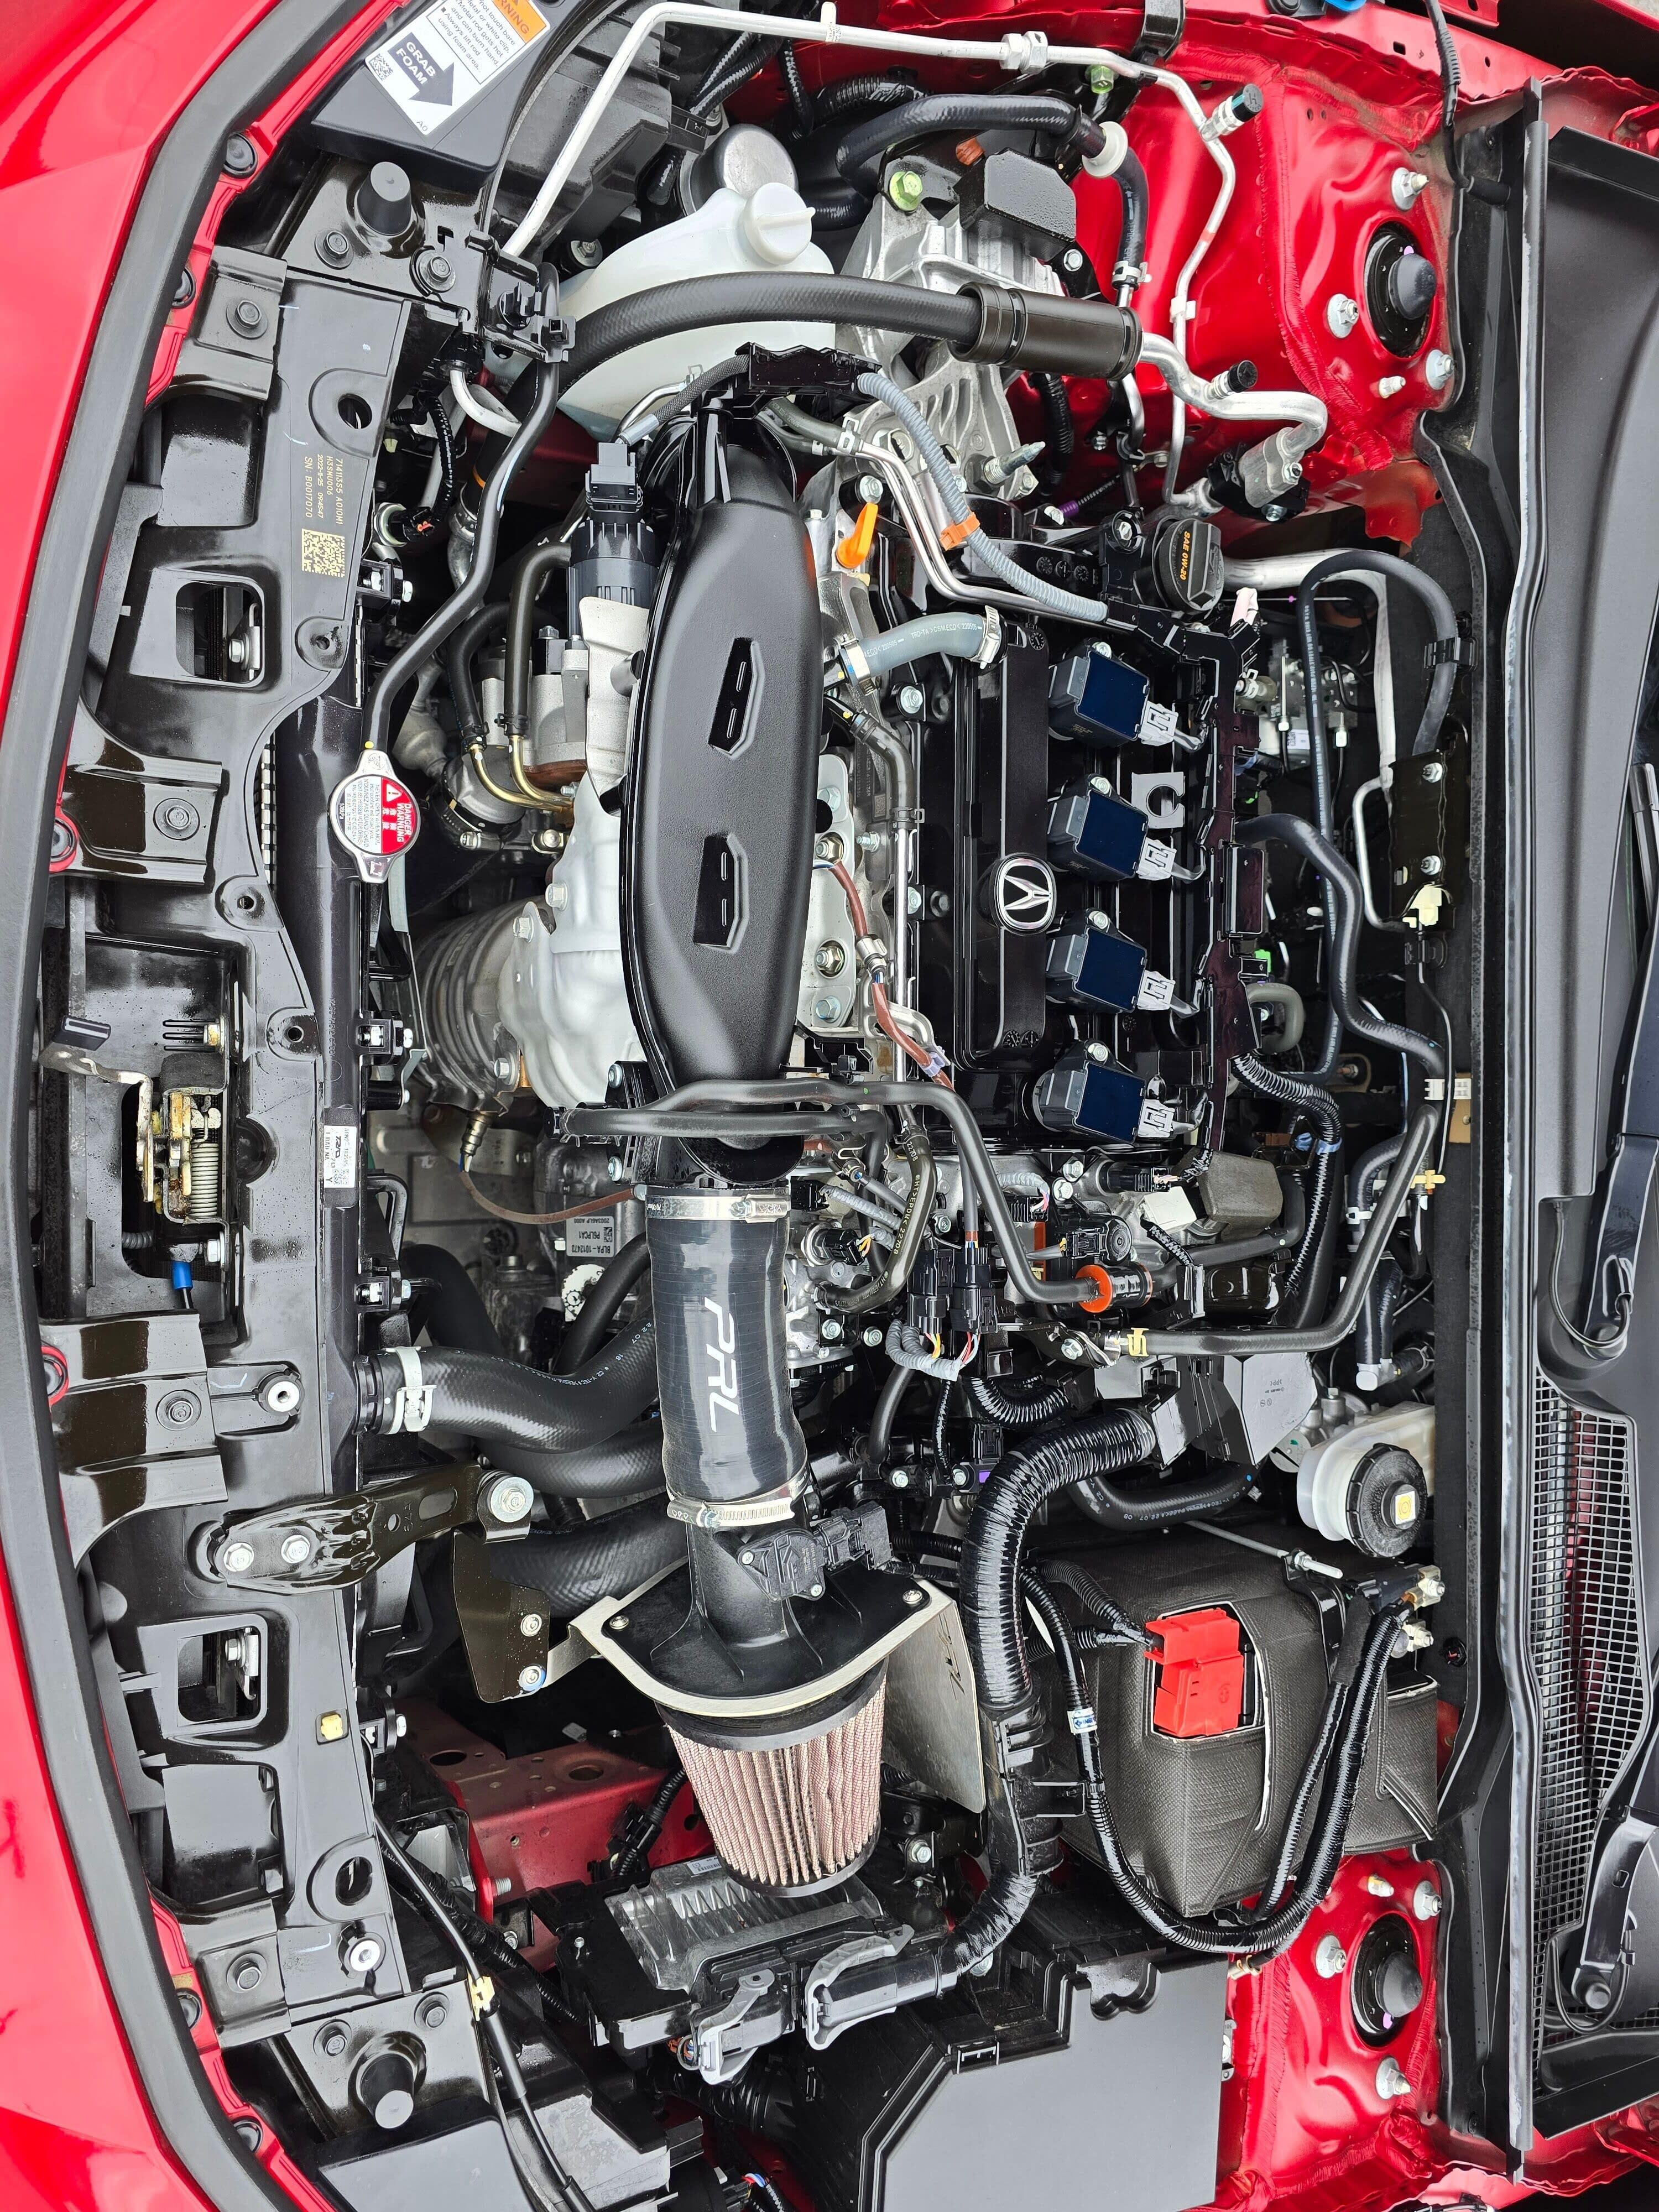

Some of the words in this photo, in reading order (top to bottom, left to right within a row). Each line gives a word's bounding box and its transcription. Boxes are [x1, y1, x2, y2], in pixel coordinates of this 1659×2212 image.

[436, 17, 454, 37] using
[452, 35, 468, 54] foam
[465, 53, 481, 71] area.
[444, 12, 466, 36] Always
[463, 35, 472, 45] lift
[469, 44, 481, 56] rod
[450, 6, 463, 21] and
[461, 20, 473, 34] can
[471, 32, 486, 49] burn
[483, 48, 501, 67] hand.
[457, 1, 474, 20] Metal
[472, 19, 484, 32] rod
[479, 30, 495, 47] gets
[493, 45, 504, 58] hot
[478, 14, 487, 23] or
[484, 21, 501, 40] white
[498, 39, 512, 54] clip.
[488, 12, 505, 31] touch
[502, 29, 517, 46] bare
[395, 47, 428, 85] FOAM
[404, 40, 437, 78] GRAB
[1182, 531, 1191, 551] SAE
[1180, 552, 1188, 580] 0W-20
[397, 803, 405, 842] WARNUNG
[907, 1141, 919, 1161] 22708
[893, 1228, 905, 1255] 22708
[704, 1297, 739, 1432] PRL
